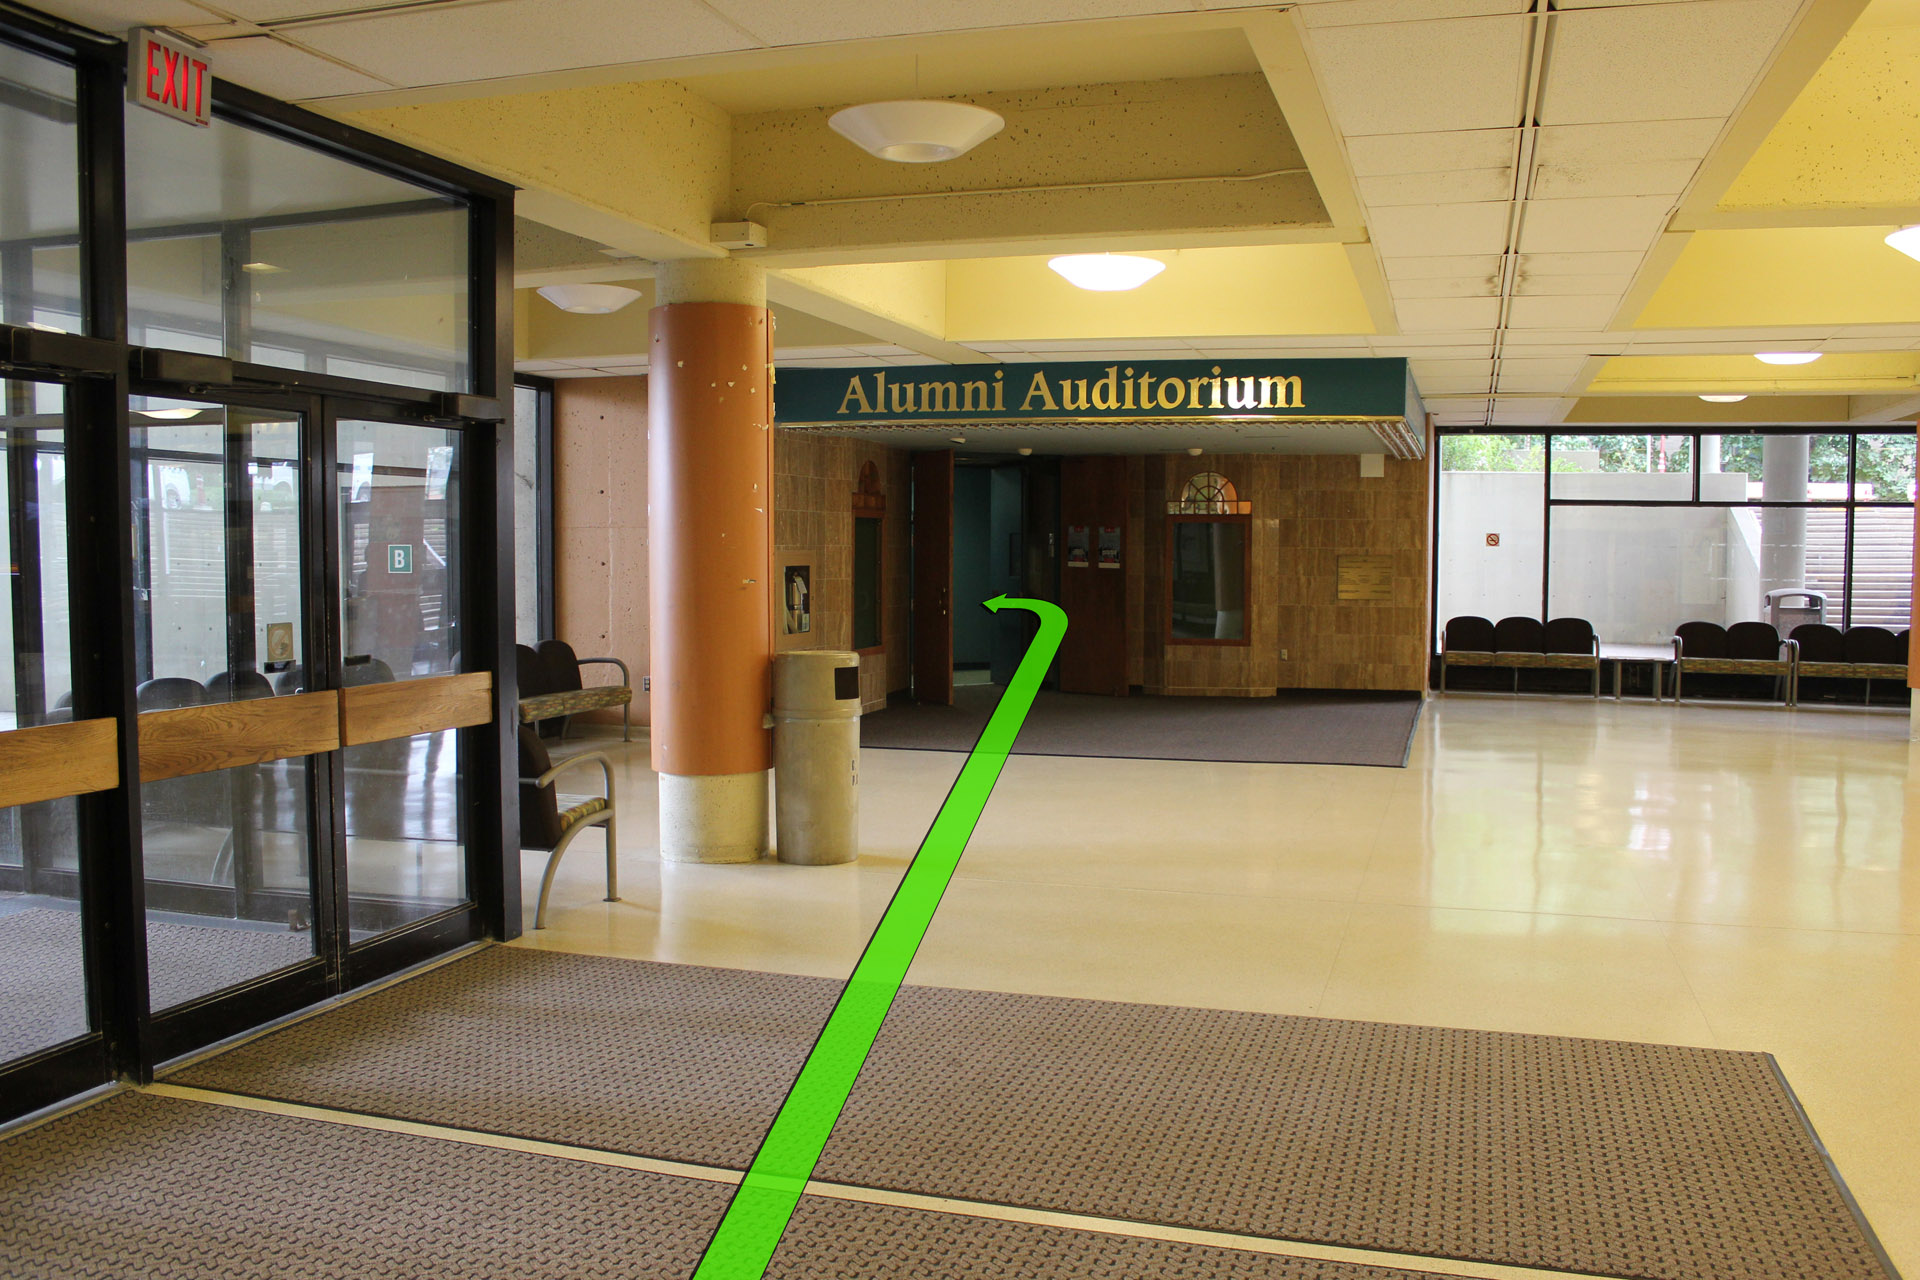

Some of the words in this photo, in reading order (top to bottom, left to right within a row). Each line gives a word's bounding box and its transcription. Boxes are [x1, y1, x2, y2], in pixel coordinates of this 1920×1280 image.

[147, 40, 207, 117] EXIT
[837, 370, 1006, 414] Alumni
[1019, 366, 1306, 411] Auditorium
[394, 549, 405, 569] B
